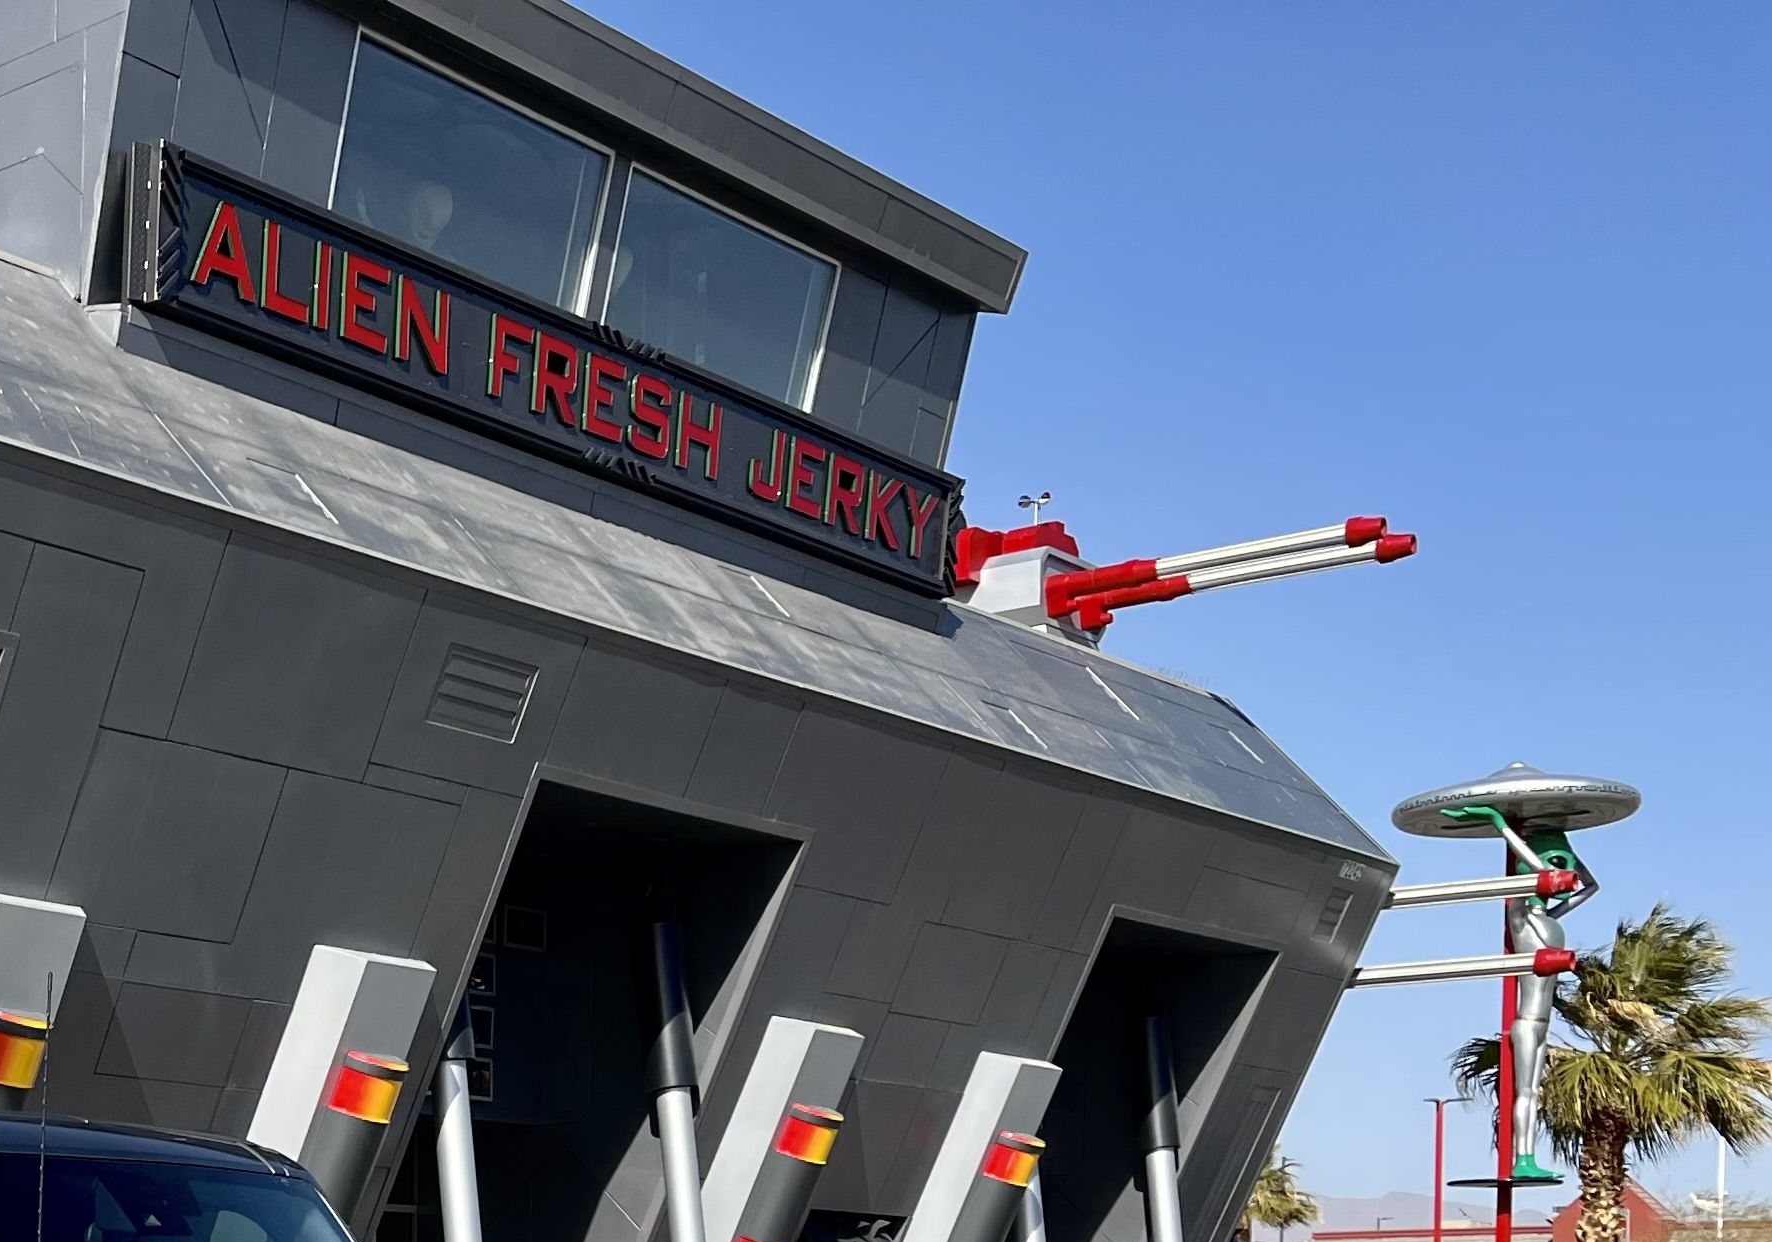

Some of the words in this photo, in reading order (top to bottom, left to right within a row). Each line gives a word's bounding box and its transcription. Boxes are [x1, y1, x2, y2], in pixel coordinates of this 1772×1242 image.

[189, 200, 450, 375] ALIEN
[486, 312, 724, 481] FRESH
[748, 428, 939, 558] JERKY
